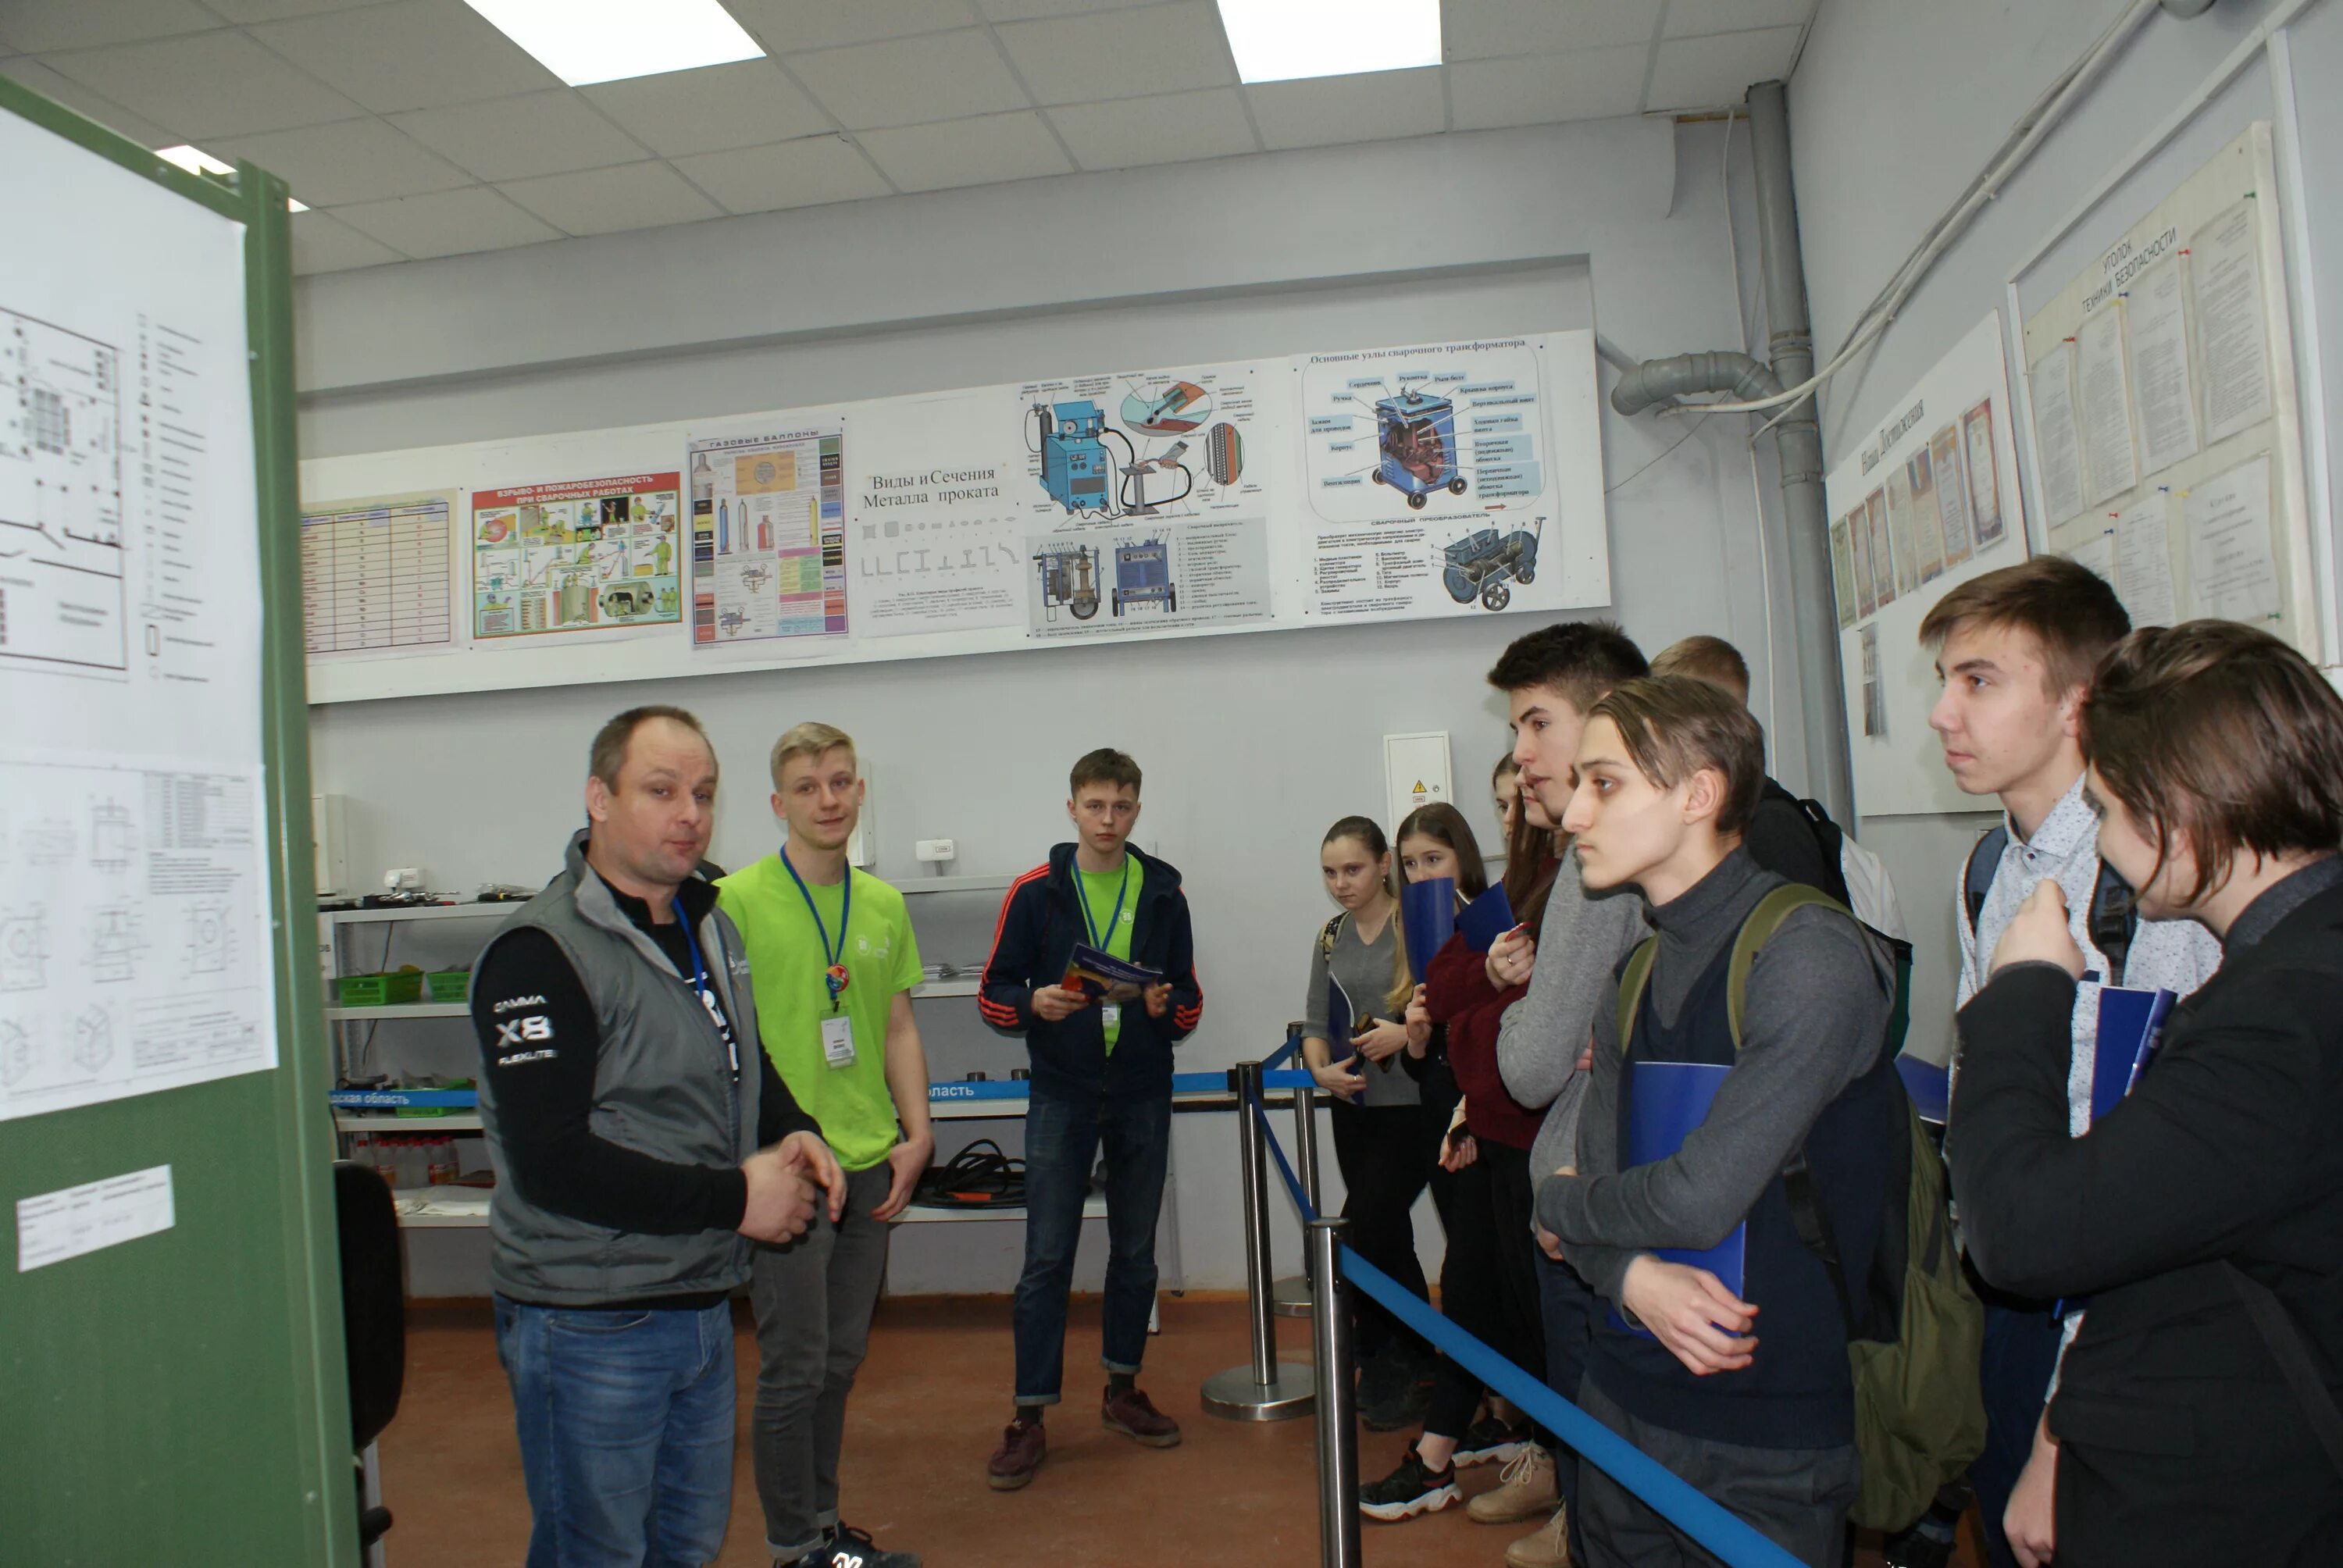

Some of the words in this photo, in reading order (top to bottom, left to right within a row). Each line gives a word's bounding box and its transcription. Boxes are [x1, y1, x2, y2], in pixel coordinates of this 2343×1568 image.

[2102, 239, 2131, 274] УГОЛОК
[2082, 280, 2113, 312] ТЕХНИКИ
[2114, 227, 2177, 287] БЕЗОПАСНОСТИ
[1311, 351, 1360, 364] Основные
[1361, 351, 1385, 362] узлы
[1388, 346, 1443, 358] сварочного
[1446, 339, 1525, 353] трансформатора
[710, 437, 759, 448] ГАЗОВЫЕ
[764, 430, 819, 442] БАЛЛОНЫ
[497, 488, 534, 497] ВЗРЫВО-
[546, 476, 654, 493] ПОЖАРОБЕЗОПАСНОСТЬ
[872, 476, 914, 490] Виды
[920, 476, 928, 485] и
[930, 469, 995, 484] Сечения
[516, 495, 534, 504] ПРИ
[537, 490, 591, 503] СВАРОЧНЫХ
[594, 486, 634, 497] РАБОТАХ
[863, 493, 929, 508] Металла
[939, 486, 999, 504] проката
[1420, 513, 1490, 522] ПРЕОБРАЗОВАТЕЛЬ
[494, 1015, 555, 1047] X8
[364, 1092, 409, 1104] область
[929, 1086, 974, 1097] ласть
